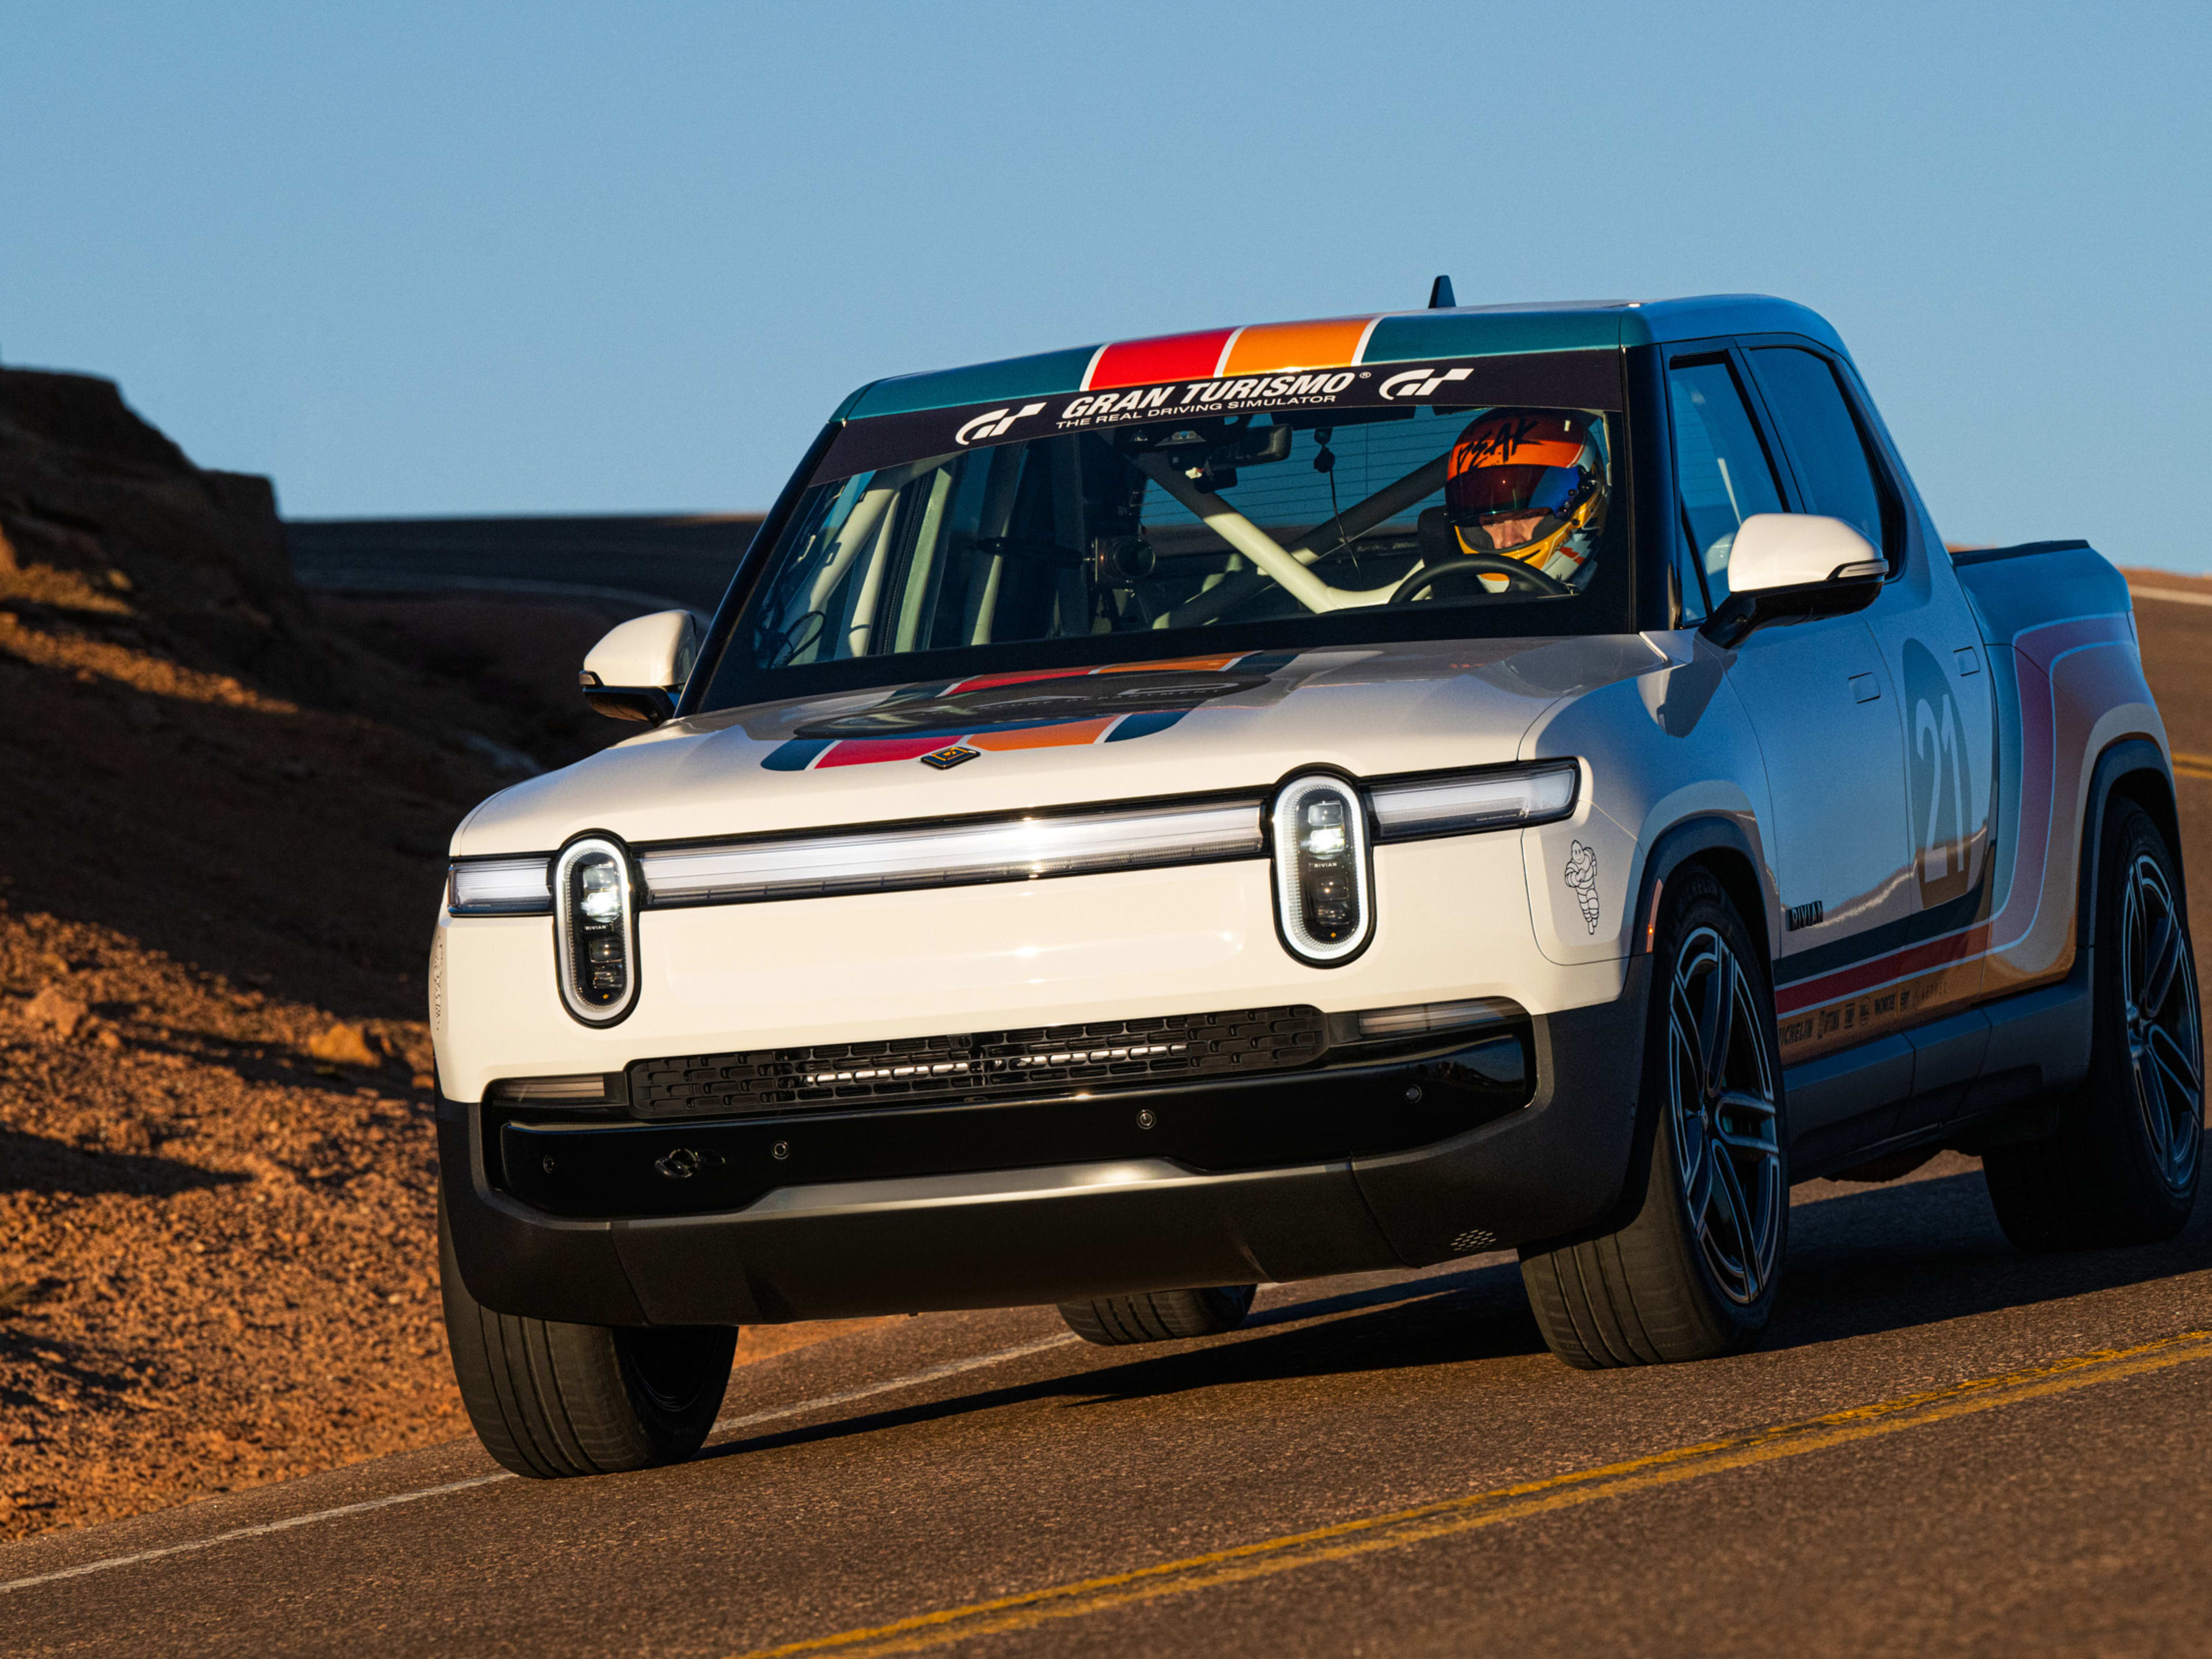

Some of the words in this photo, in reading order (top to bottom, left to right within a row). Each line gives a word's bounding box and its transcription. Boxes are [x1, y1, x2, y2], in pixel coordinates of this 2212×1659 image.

[1056, 417, 1092, 429] THE
[1095, 411, 1143, 423] REAL
[1147, 403, 1222, 418] DRIVING
[1228, 395, 1336, 409] SIMULATOR
[1062, 386, 1176, 419] GRAN
[1180, 372, 1355, 404] TURISMO
[1915, 694, 1964, 883] 21
[1790, 900, 1823, 931] RIVIAN
